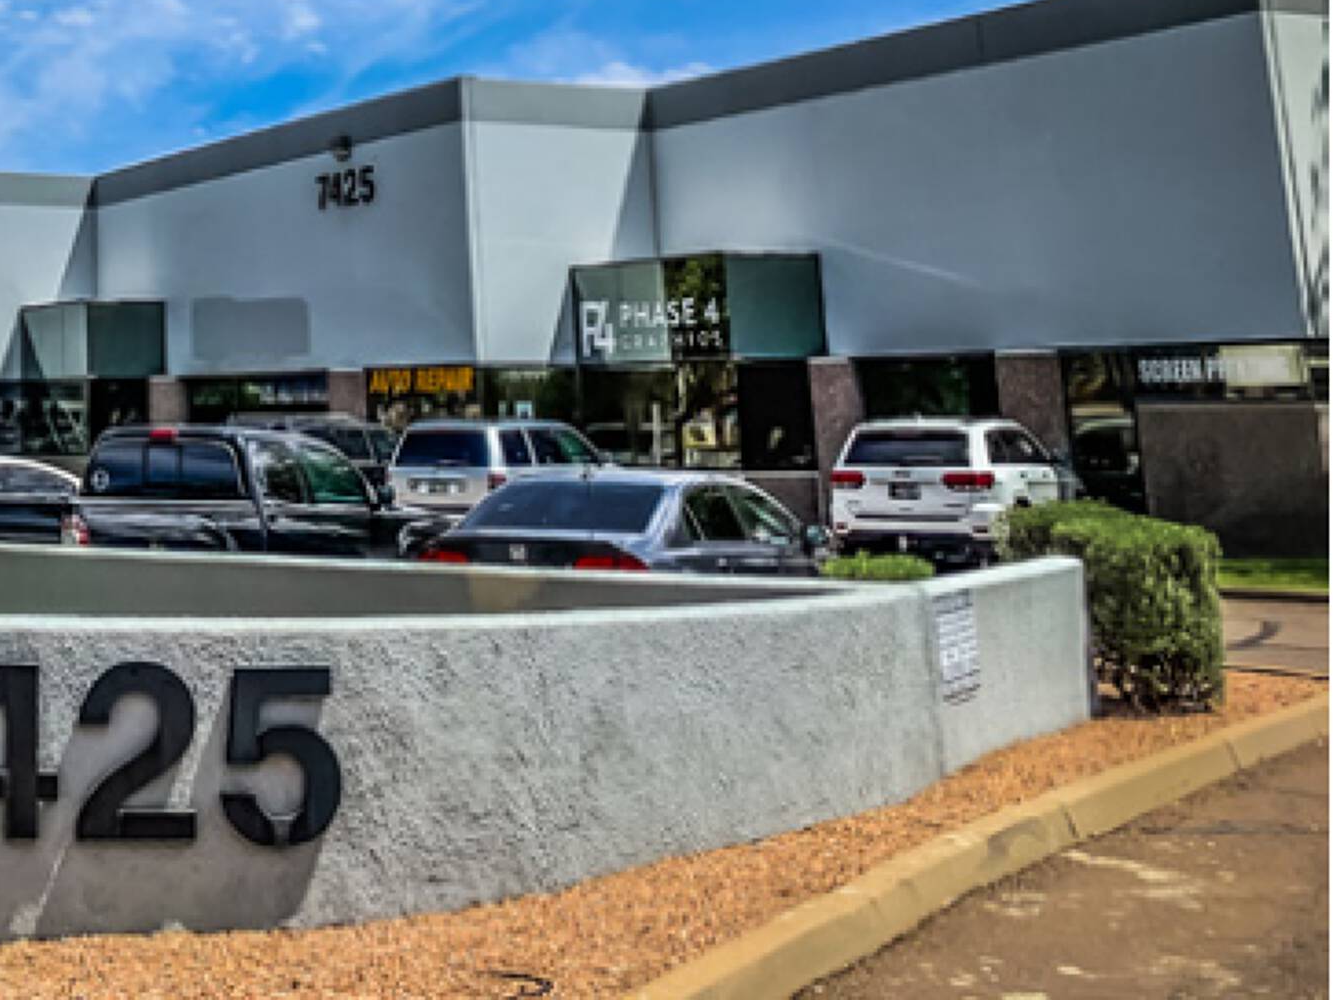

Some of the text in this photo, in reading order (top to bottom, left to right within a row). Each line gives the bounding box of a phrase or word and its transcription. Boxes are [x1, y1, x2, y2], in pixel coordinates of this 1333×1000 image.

[314, 164, 375, 210] 7425
[619, 297, 720, 328] PHASE 4
[1138, 357, 1202, 383] SCREEN
